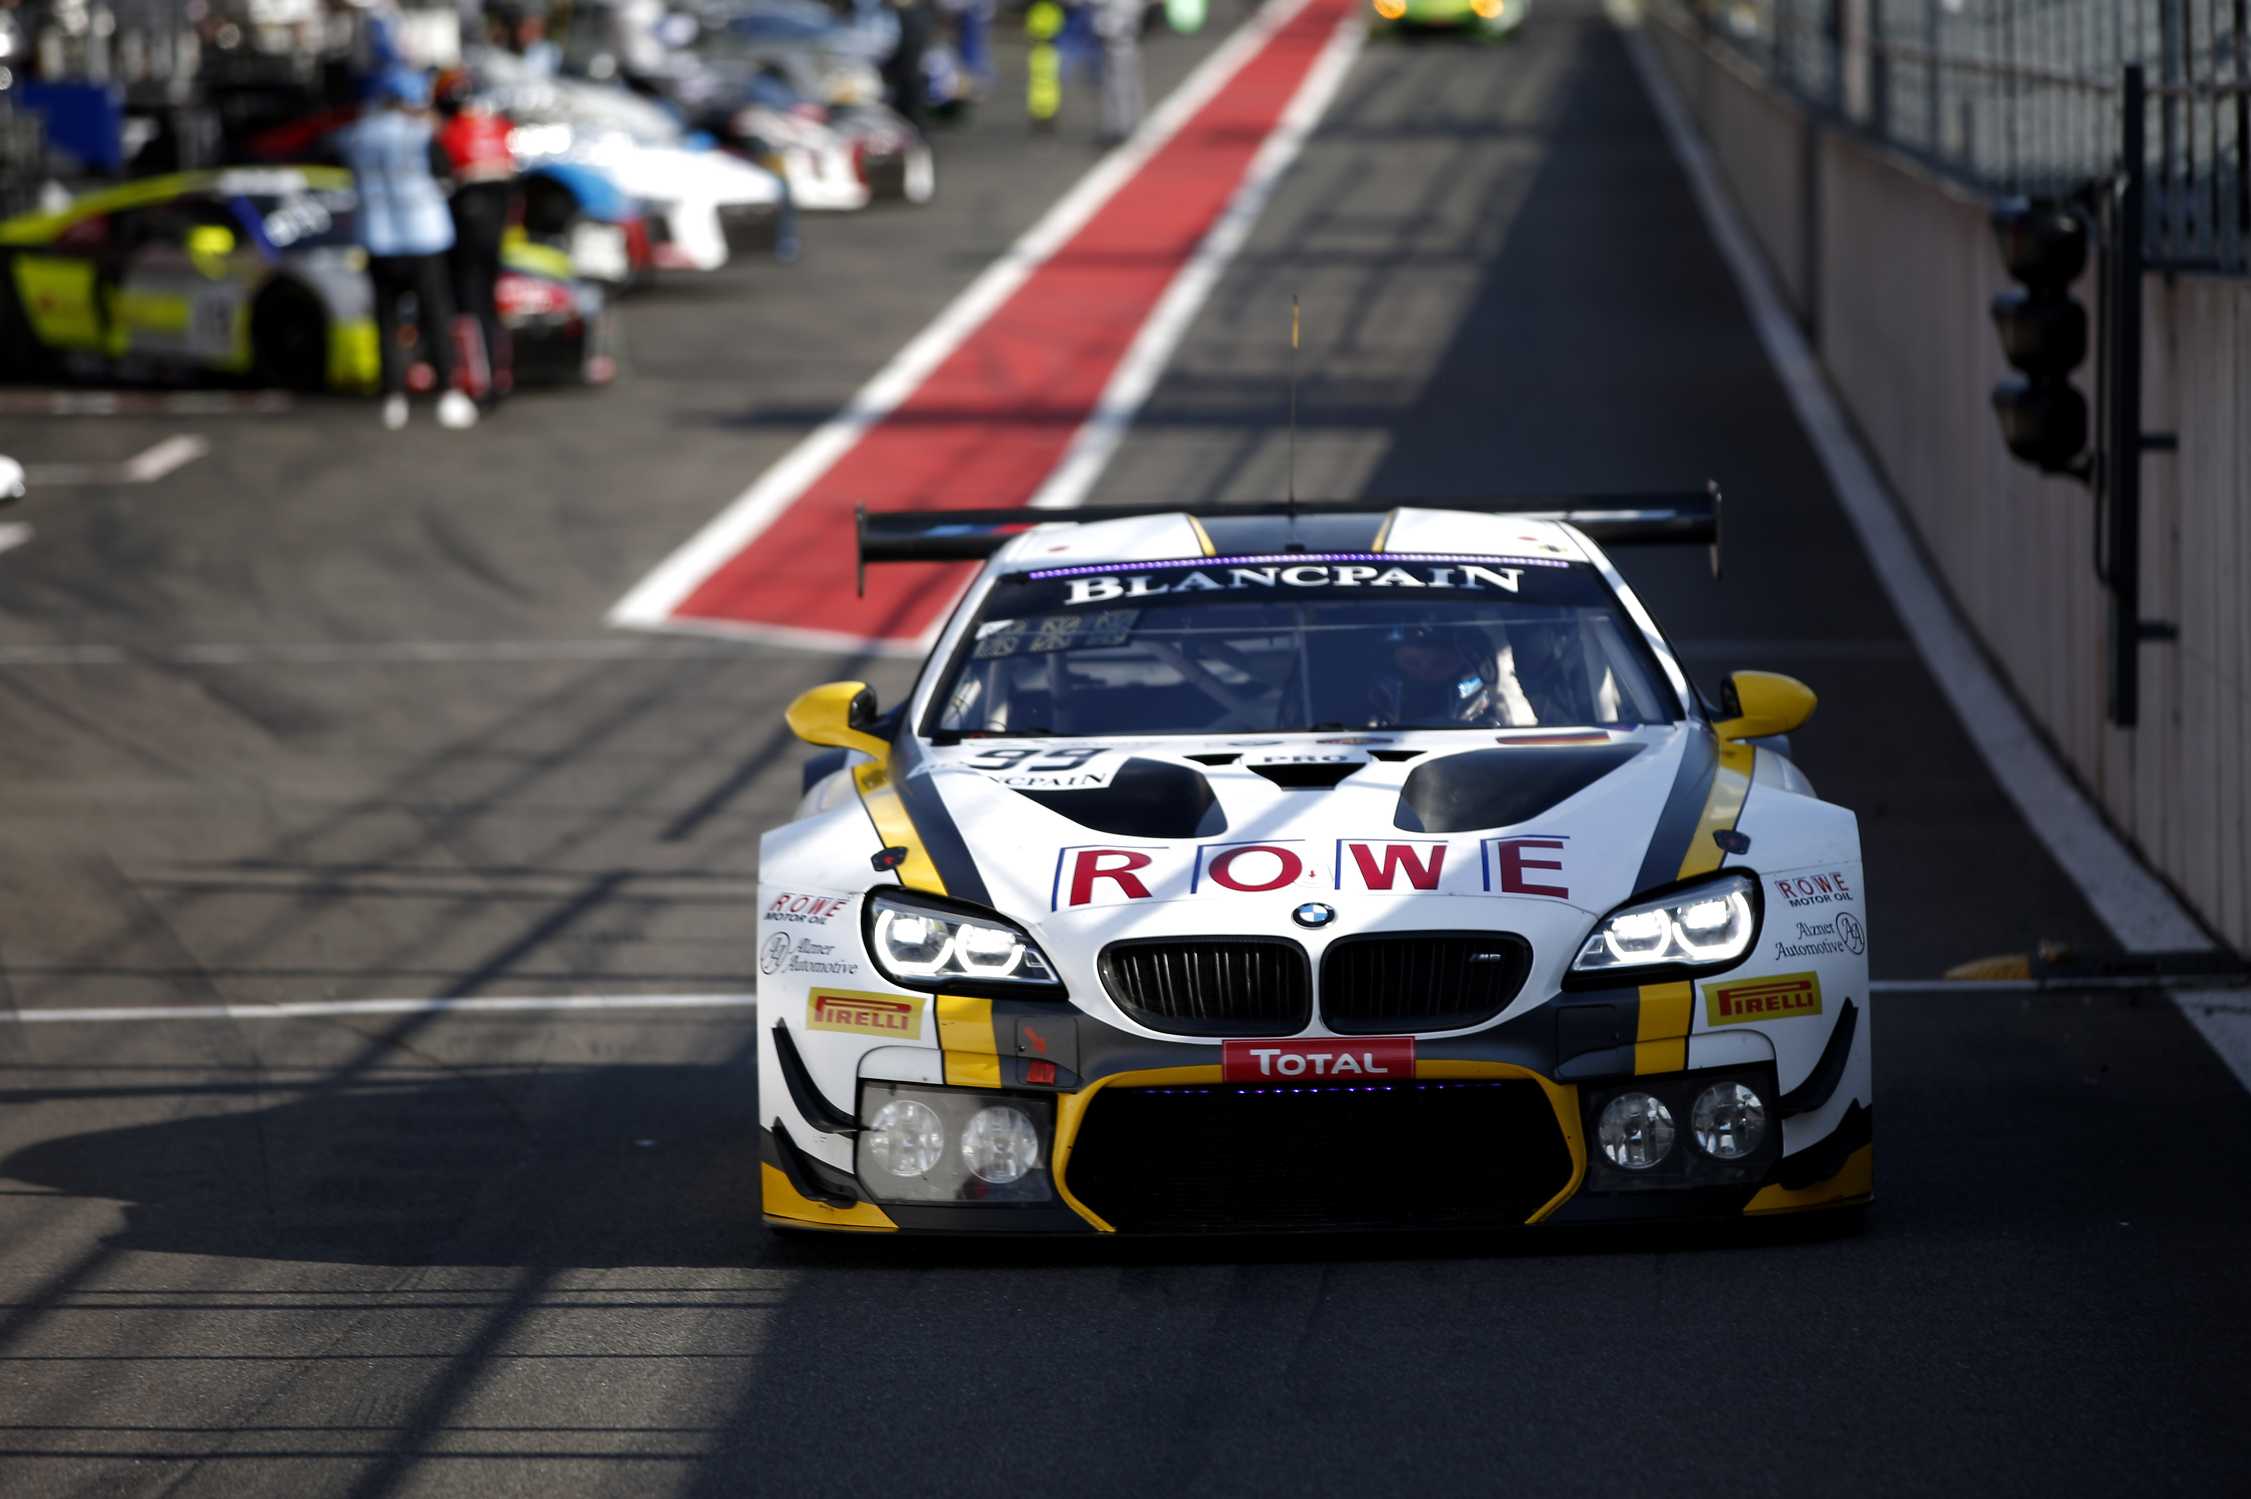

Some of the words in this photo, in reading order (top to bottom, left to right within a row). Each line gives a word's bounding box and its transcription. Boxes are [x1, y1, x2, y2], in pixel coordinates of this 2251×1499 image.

[1064, 566, 1525, 605] BLANCPAIN
[968, 747, 1112, 771] 99
[1069, 840, 1569, 907] ROWE
[1774, 872, 1850, 899] ROWE
[768, 893, 847, 918] ROWE
[1789, 895, 1832, 907] MOTOR
[1834, 892, 1854, 902] OIL
[763, 912, 807, 923] MOTOR
[1775, 939, 1845, 961] Automotive
[1717, 980, 1815, 1017] PIRELLI
[814, 995, 912, 1031] PIRELLI
[1249, 1048, 1388, 1076] TOTAL
